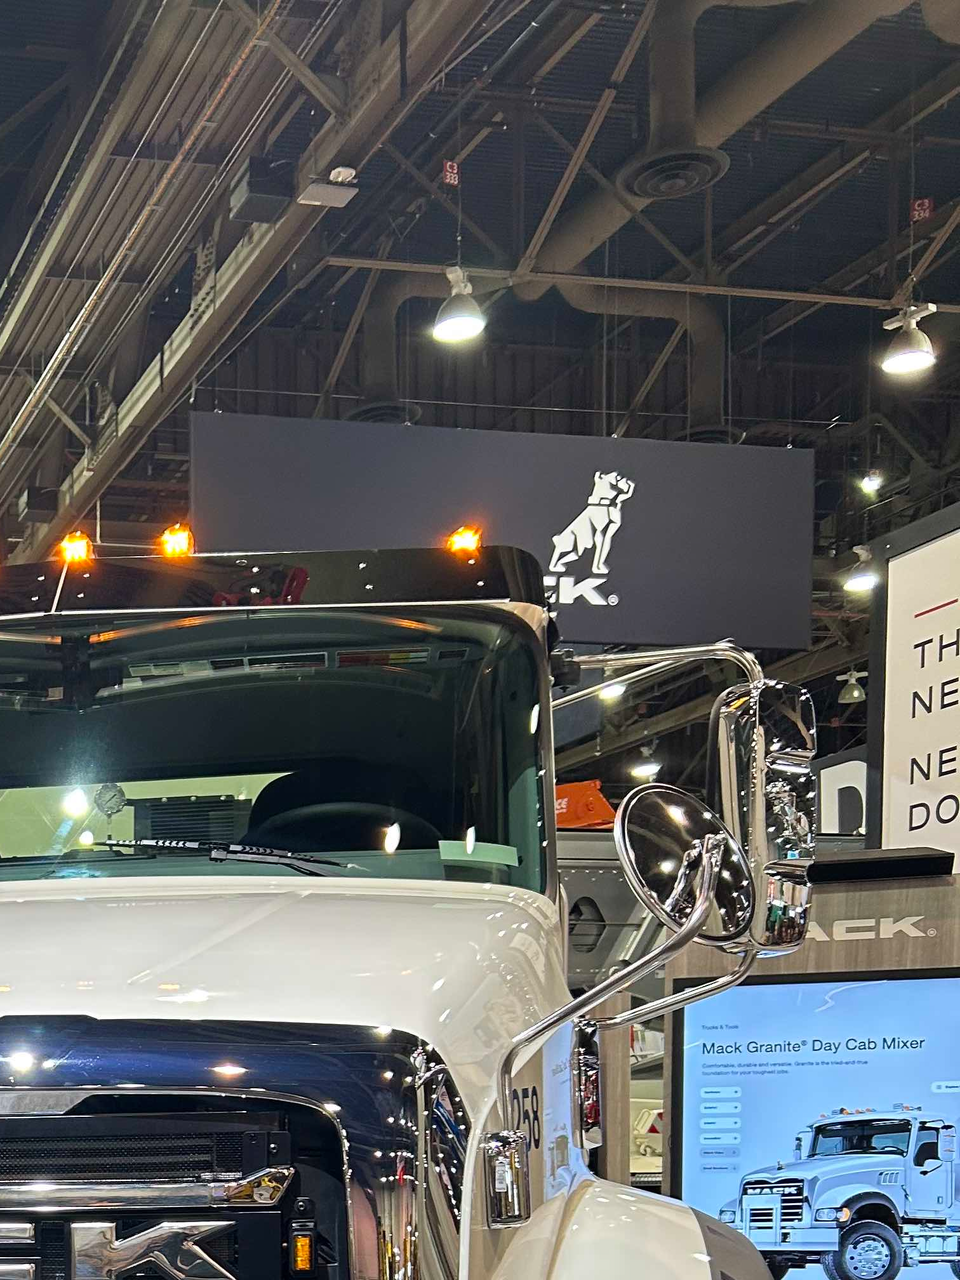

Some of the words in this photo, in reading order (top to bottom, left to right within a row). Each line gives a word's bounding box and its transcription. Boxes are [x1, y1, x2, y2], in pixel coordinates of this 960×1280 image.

[914, 628, 960, 669] TH
[912, 676, 959, 719] NE
[910, 745, 958, 785] NE
[909, 794, 960, 832] DO
[702, 1041, 743, 1055] Mack
[812, 1039, 841, 1054] Day
[845, 1037, 877, 1051] Cab
[882, 1036, 926, 1050] Mixer
[747, 1186, 798, 1195] MACK
